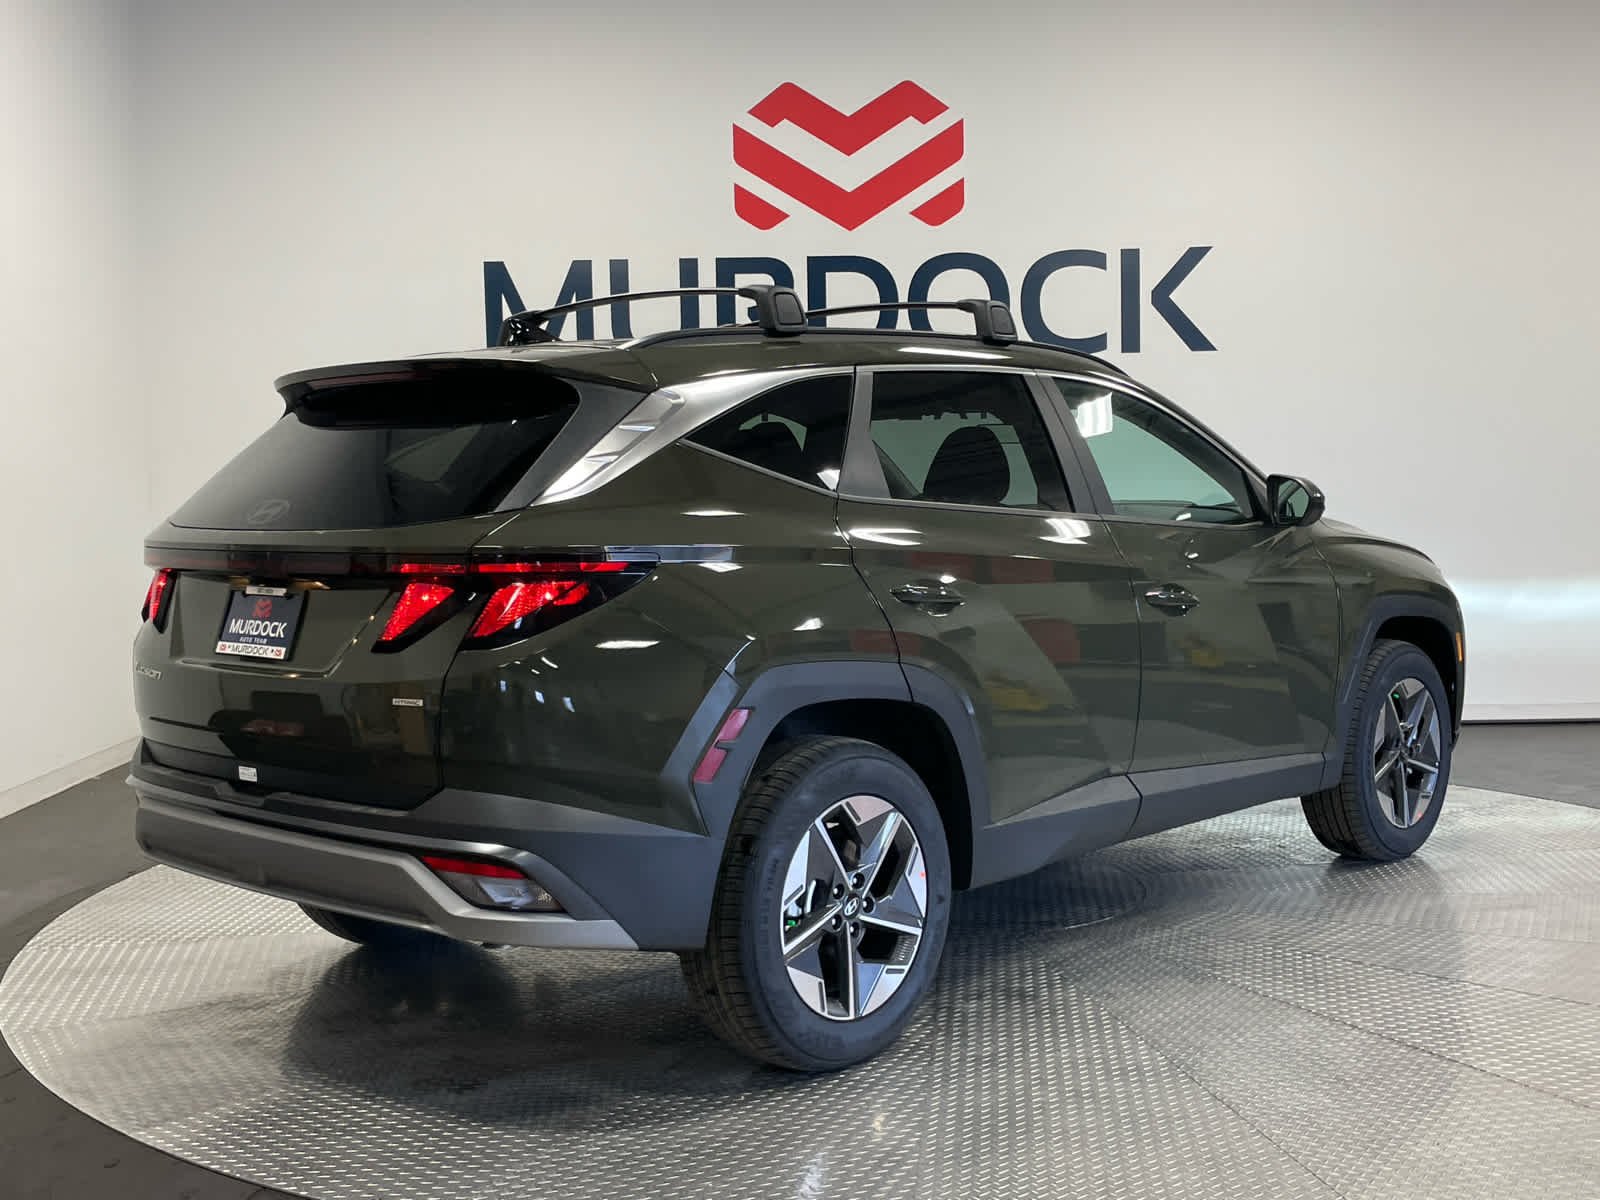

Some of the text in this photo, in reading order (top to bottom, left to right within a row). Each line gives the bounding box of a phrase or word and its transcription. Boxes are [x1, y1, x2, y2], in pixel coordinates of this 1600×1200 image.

[484, 246, 1217, 353] MURDOCK
[229, 618, 287, 638] MURDOCK
[231, 644, 269, 655] MURDOCK
